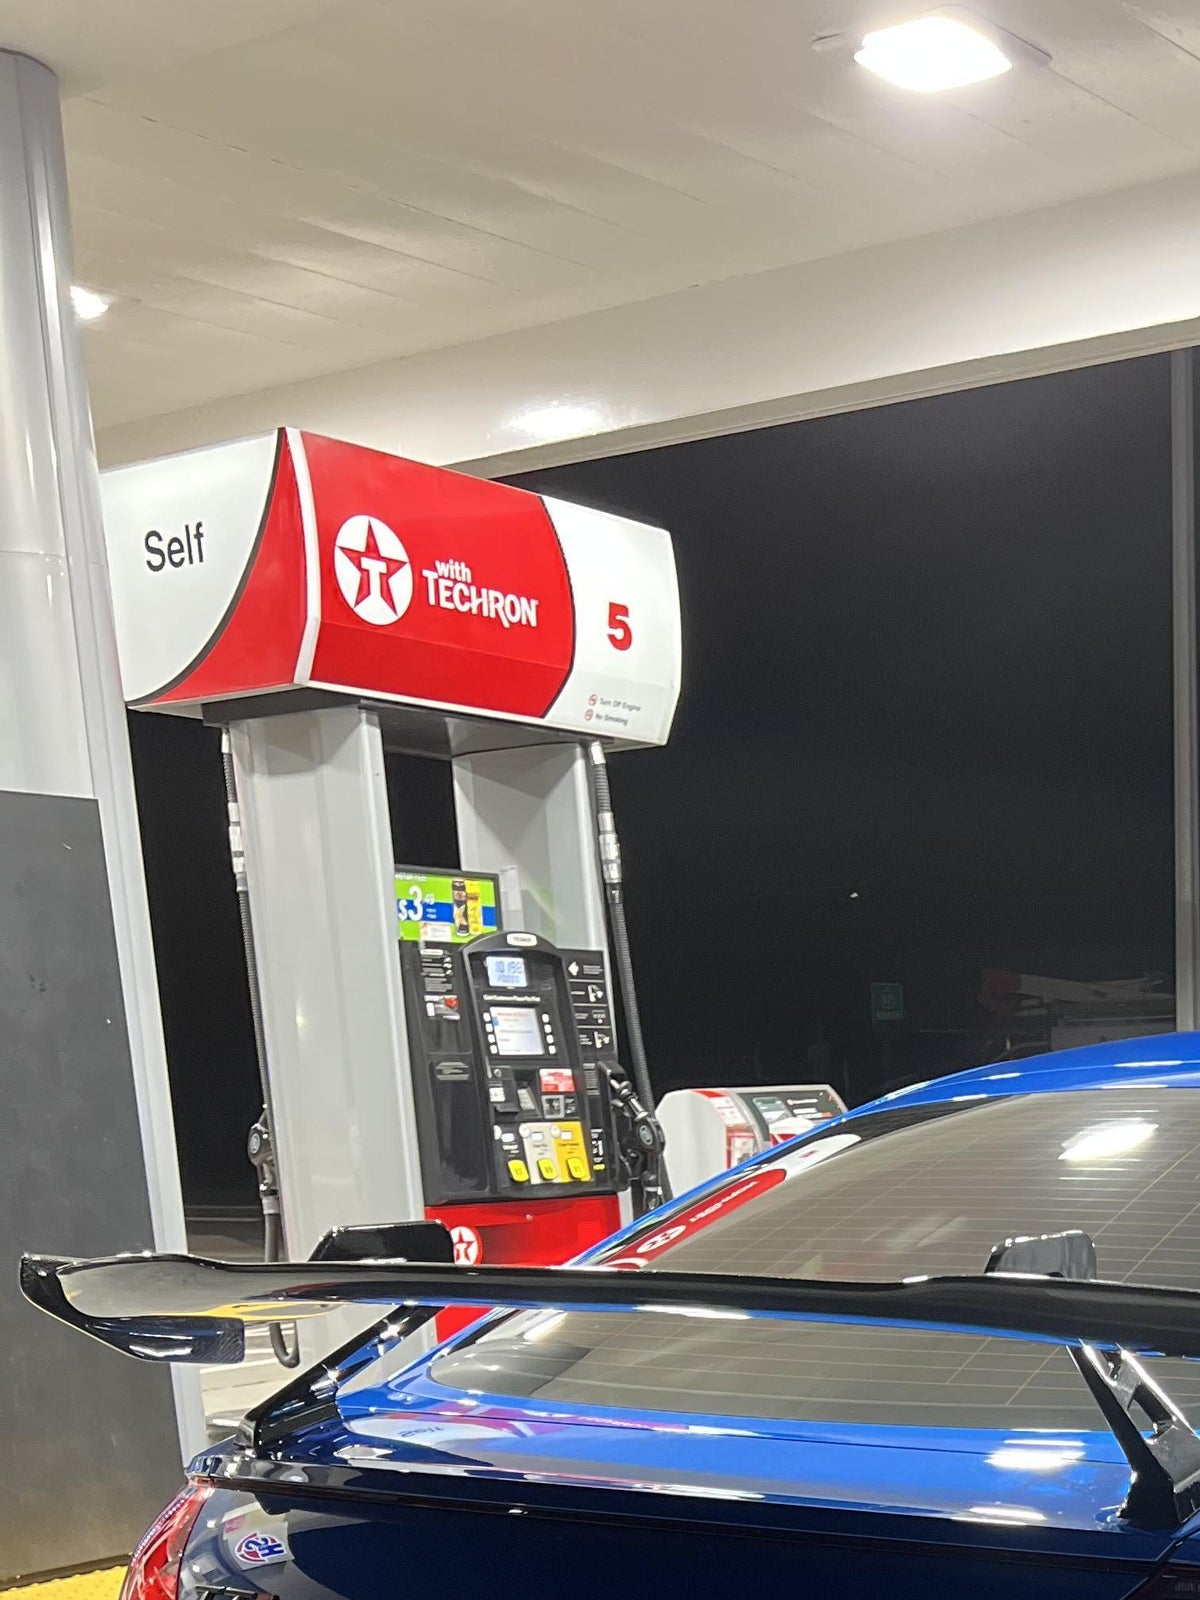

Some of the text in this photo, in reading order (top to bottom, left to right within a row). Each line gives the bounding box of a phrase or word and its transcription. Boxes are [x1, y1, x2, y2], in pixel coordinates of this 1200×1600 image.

[144, 523, 205, 573] Self
[435, 559, 472, 583] with
[422, 569, 540, 628] TECHRON
[606, 602, 633, 651] 5
